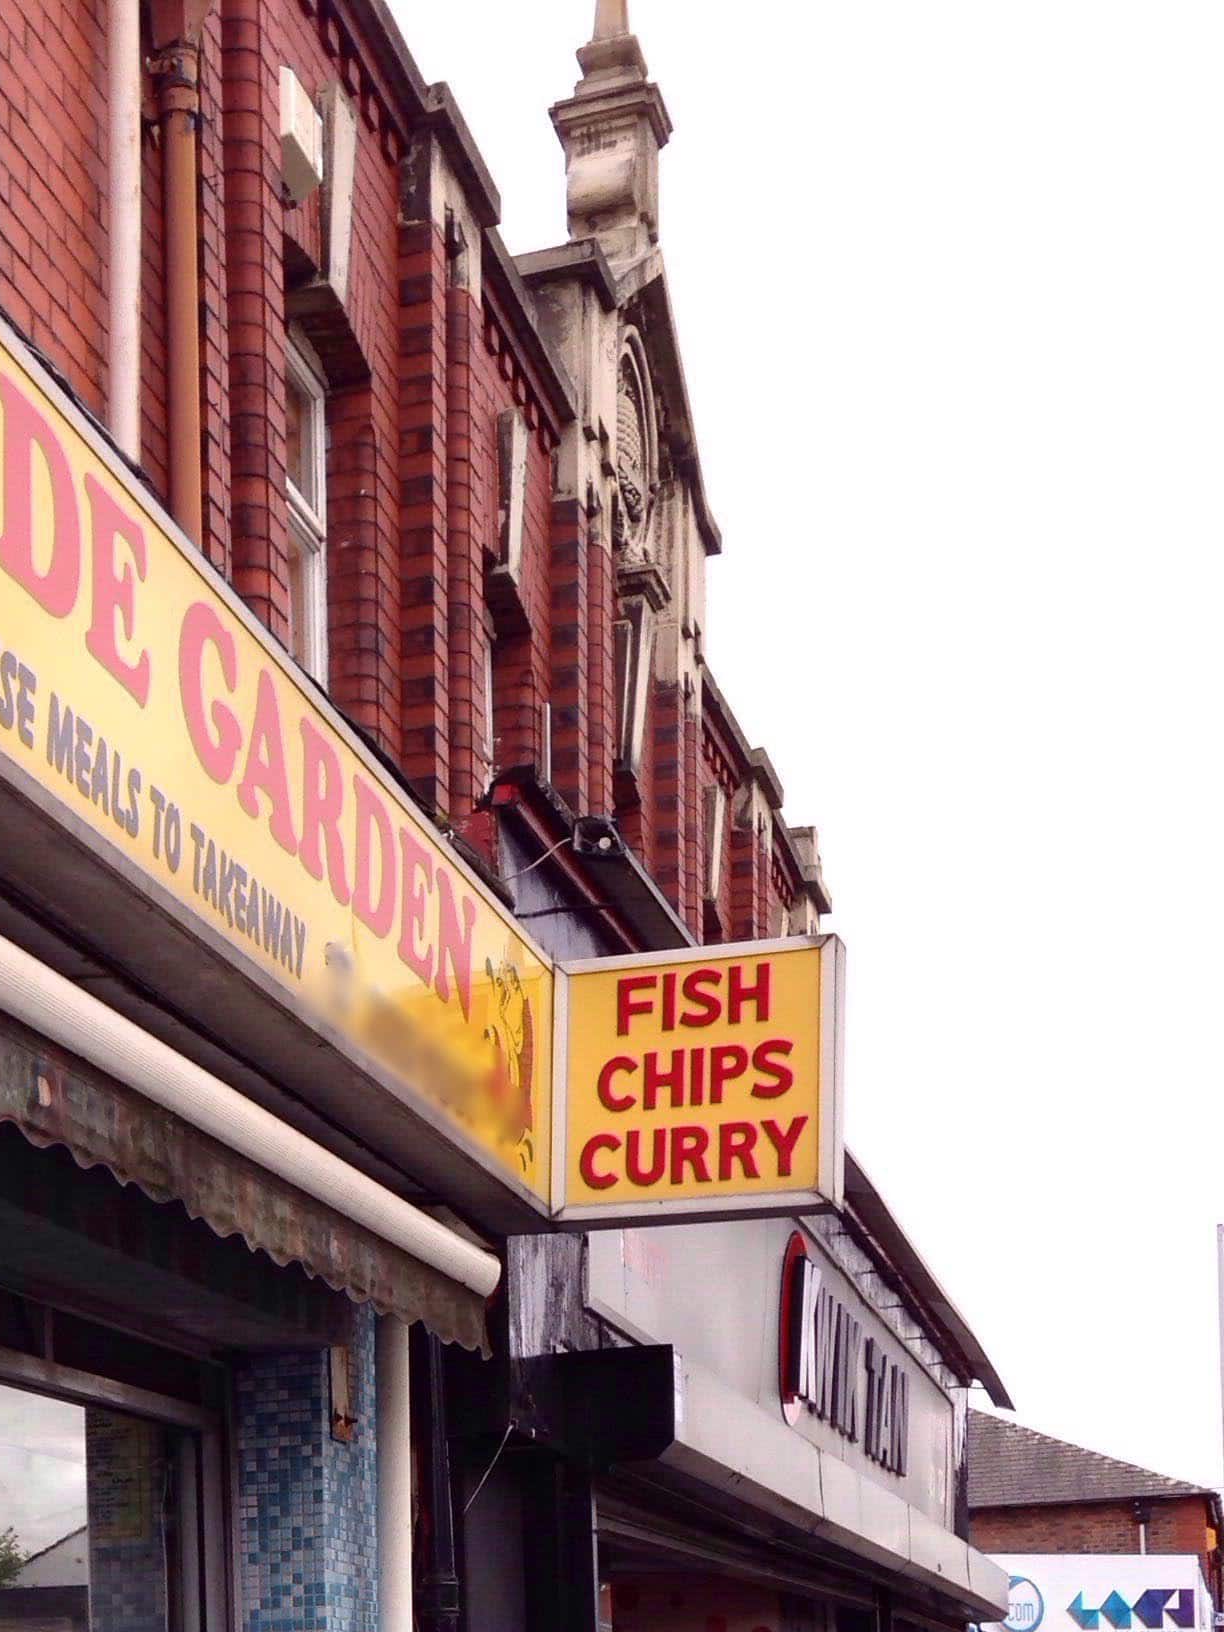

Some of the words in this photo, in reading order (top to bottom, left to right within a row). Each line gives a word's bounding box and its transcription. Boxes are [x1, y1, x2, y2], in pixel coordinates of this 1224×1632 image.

[46, 691, 141, 839] MEALS
[150, 785, 182, 874] TO
[190, 822, 306, 980] TAKEAWAY
[178, 601, 476, 1024] GARDEN
[616, 962, 771, 1037] FISH
[597, 1039, 794, 1113] CHIPS
[579, 1115, 809, 1190] CURRY
